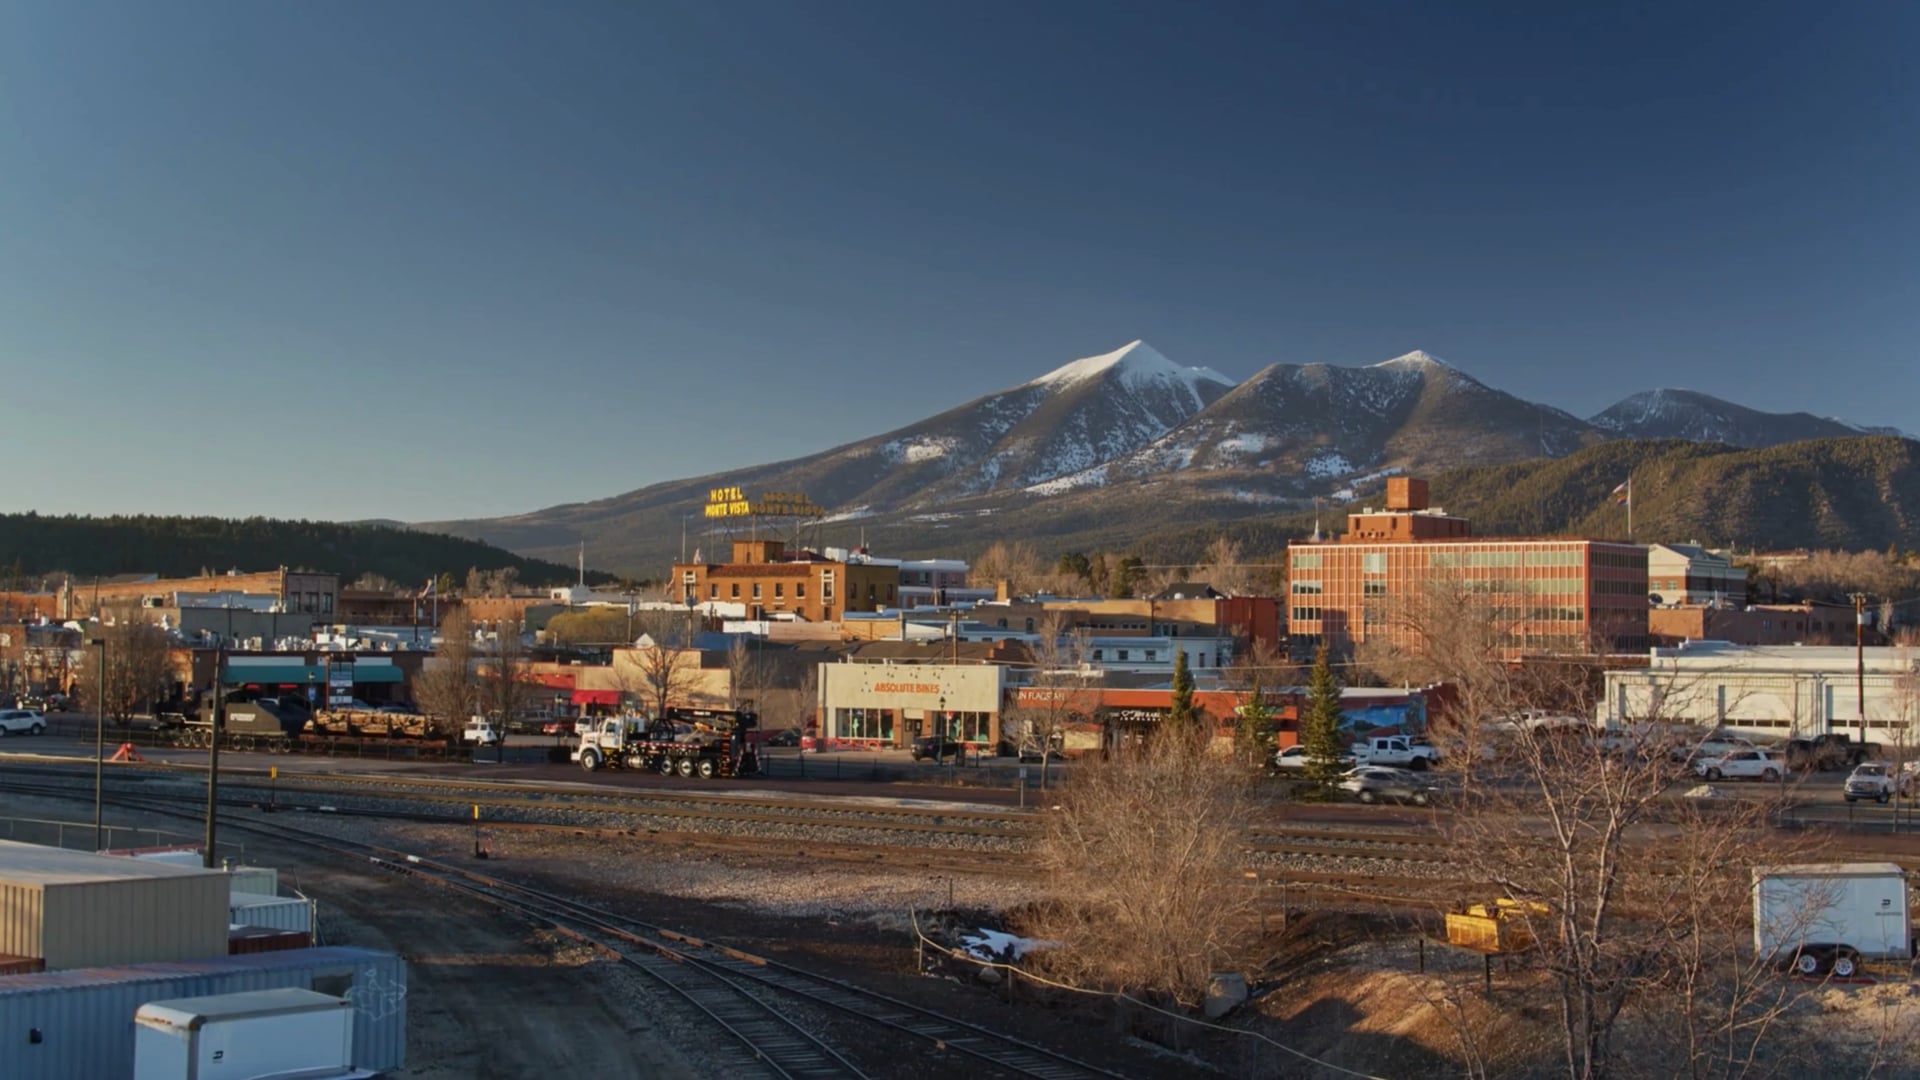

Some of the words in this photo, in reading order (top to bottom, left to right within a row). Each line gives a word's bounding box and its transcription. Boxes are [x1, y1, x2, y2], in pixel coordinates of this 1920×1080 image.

[710, 487, 743, 502] HOTEL
[705, 502, 728, 518] MONTE
[729, 501, 749, 515] VISTA
[874, 682, 915, 693] ABSOLUTE
[916, 683, 940, 694] BIKES
